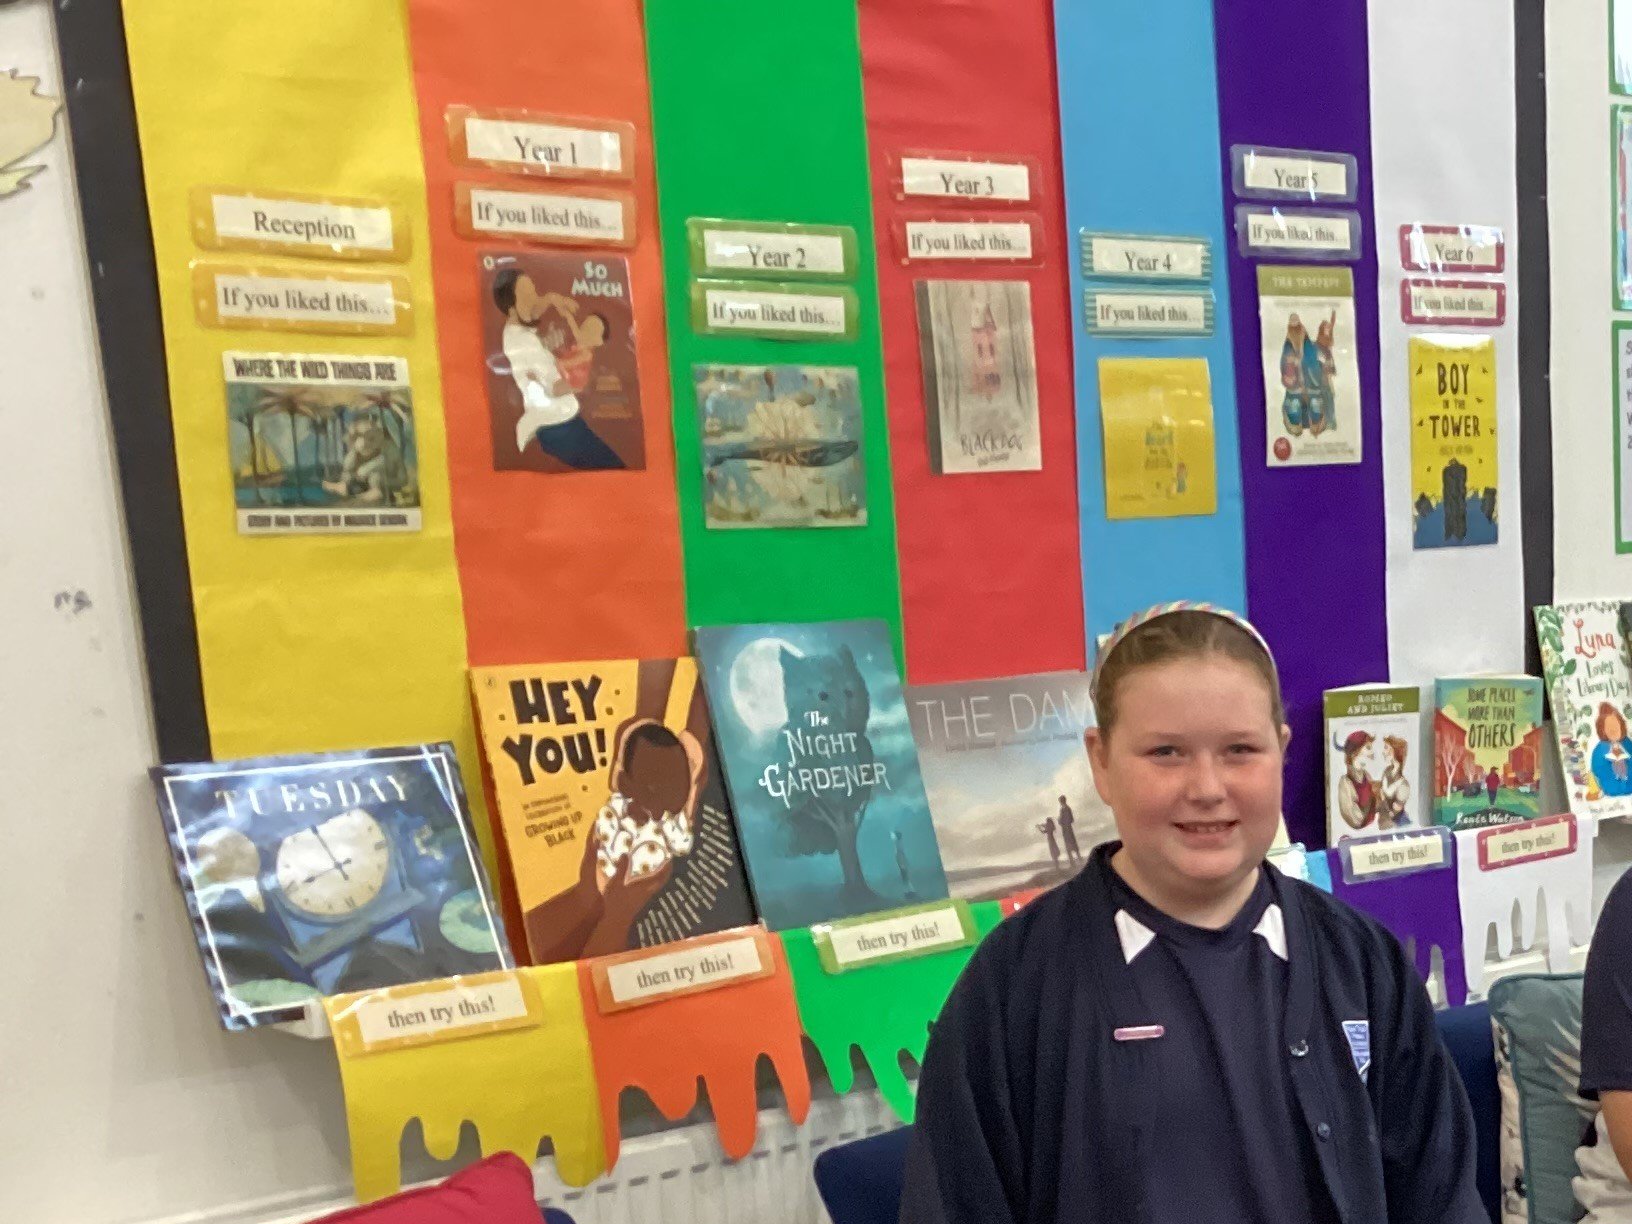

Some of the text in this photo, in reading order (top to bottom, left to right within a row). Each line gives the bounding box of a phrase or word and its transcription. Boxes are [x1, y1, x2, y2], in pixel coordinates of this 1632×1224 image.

[514, 135, 578, 164] Year 1
[940, 173, 995, 196] Year 3
[1274, 167, 1319, 189] Year 5
[253, 211, 357, 243] Reception
[477, 202, 495, 222] If
[498, 207, 527, 226] you
[531, 205, 570, 227] liked
[911, 233, 925, 250] If
[926, 237, 950, 254] you
[953, 234, 986, 252] liked
[1252, 224, 1263, 239] If
[1265, 227, 1286, 243] you
[1287, 224, 1313, 241] liked
[748, 244, 807, 270] Year 2
[1125, 251, 1172, 273] Year 4
[1435, 244, 1474, 262] Year 6
[584, 261, 608, 280] SO
[223, 287, 241, 306] If
[244, 291, 280, 312] you
[285, 289, 331, 313] liked
[571, 278, 624, 298] MUCH
[712, 302, 727, 320] If
[729, 305, 758, 325] you
[761, 303, 797, 324] liked
[1100, 304, 1111, 321] If
[1113, 308, 1136, 327] you
[1138, 305, 1166, 323] liked
[1443, 296, 1466, 311] liked
[233, 358, 397, 382] WHERE THE WILD THINGS ARE
[1437, 362, 1470, 396] BOY
[1429, 414, 1481, 439] TOWER
[1573, 618, 1617, 659] Luna
[1586, 660, 1614, 679] Loves
[509, 674, 603, 726] HEY
[1577, 677, 1630, 698] Library Day
[804, 710, 829, 728] The
[916, 696, 997, 743] THE
[783, 728, 858, 768] NIGHT
[1468, 723, 1516, 749] OTHERS
[501, 727, 607, 787] YOU!
[214, 773, 407, 819] TUESDAY
[758, 761, 892, 810] GARDENER
[525, 810, 583, 839] GROWING UP
[544, 828, 575, 848] BLACK
[1502, 834, 1555, 854] then try this!
[1369, 845, 1428, 866] then try this!
[857, 922, 940, 952] then try this!
[636, 954, 734, 990] then try this!
[388, 995, 497, 1030] then try this!
